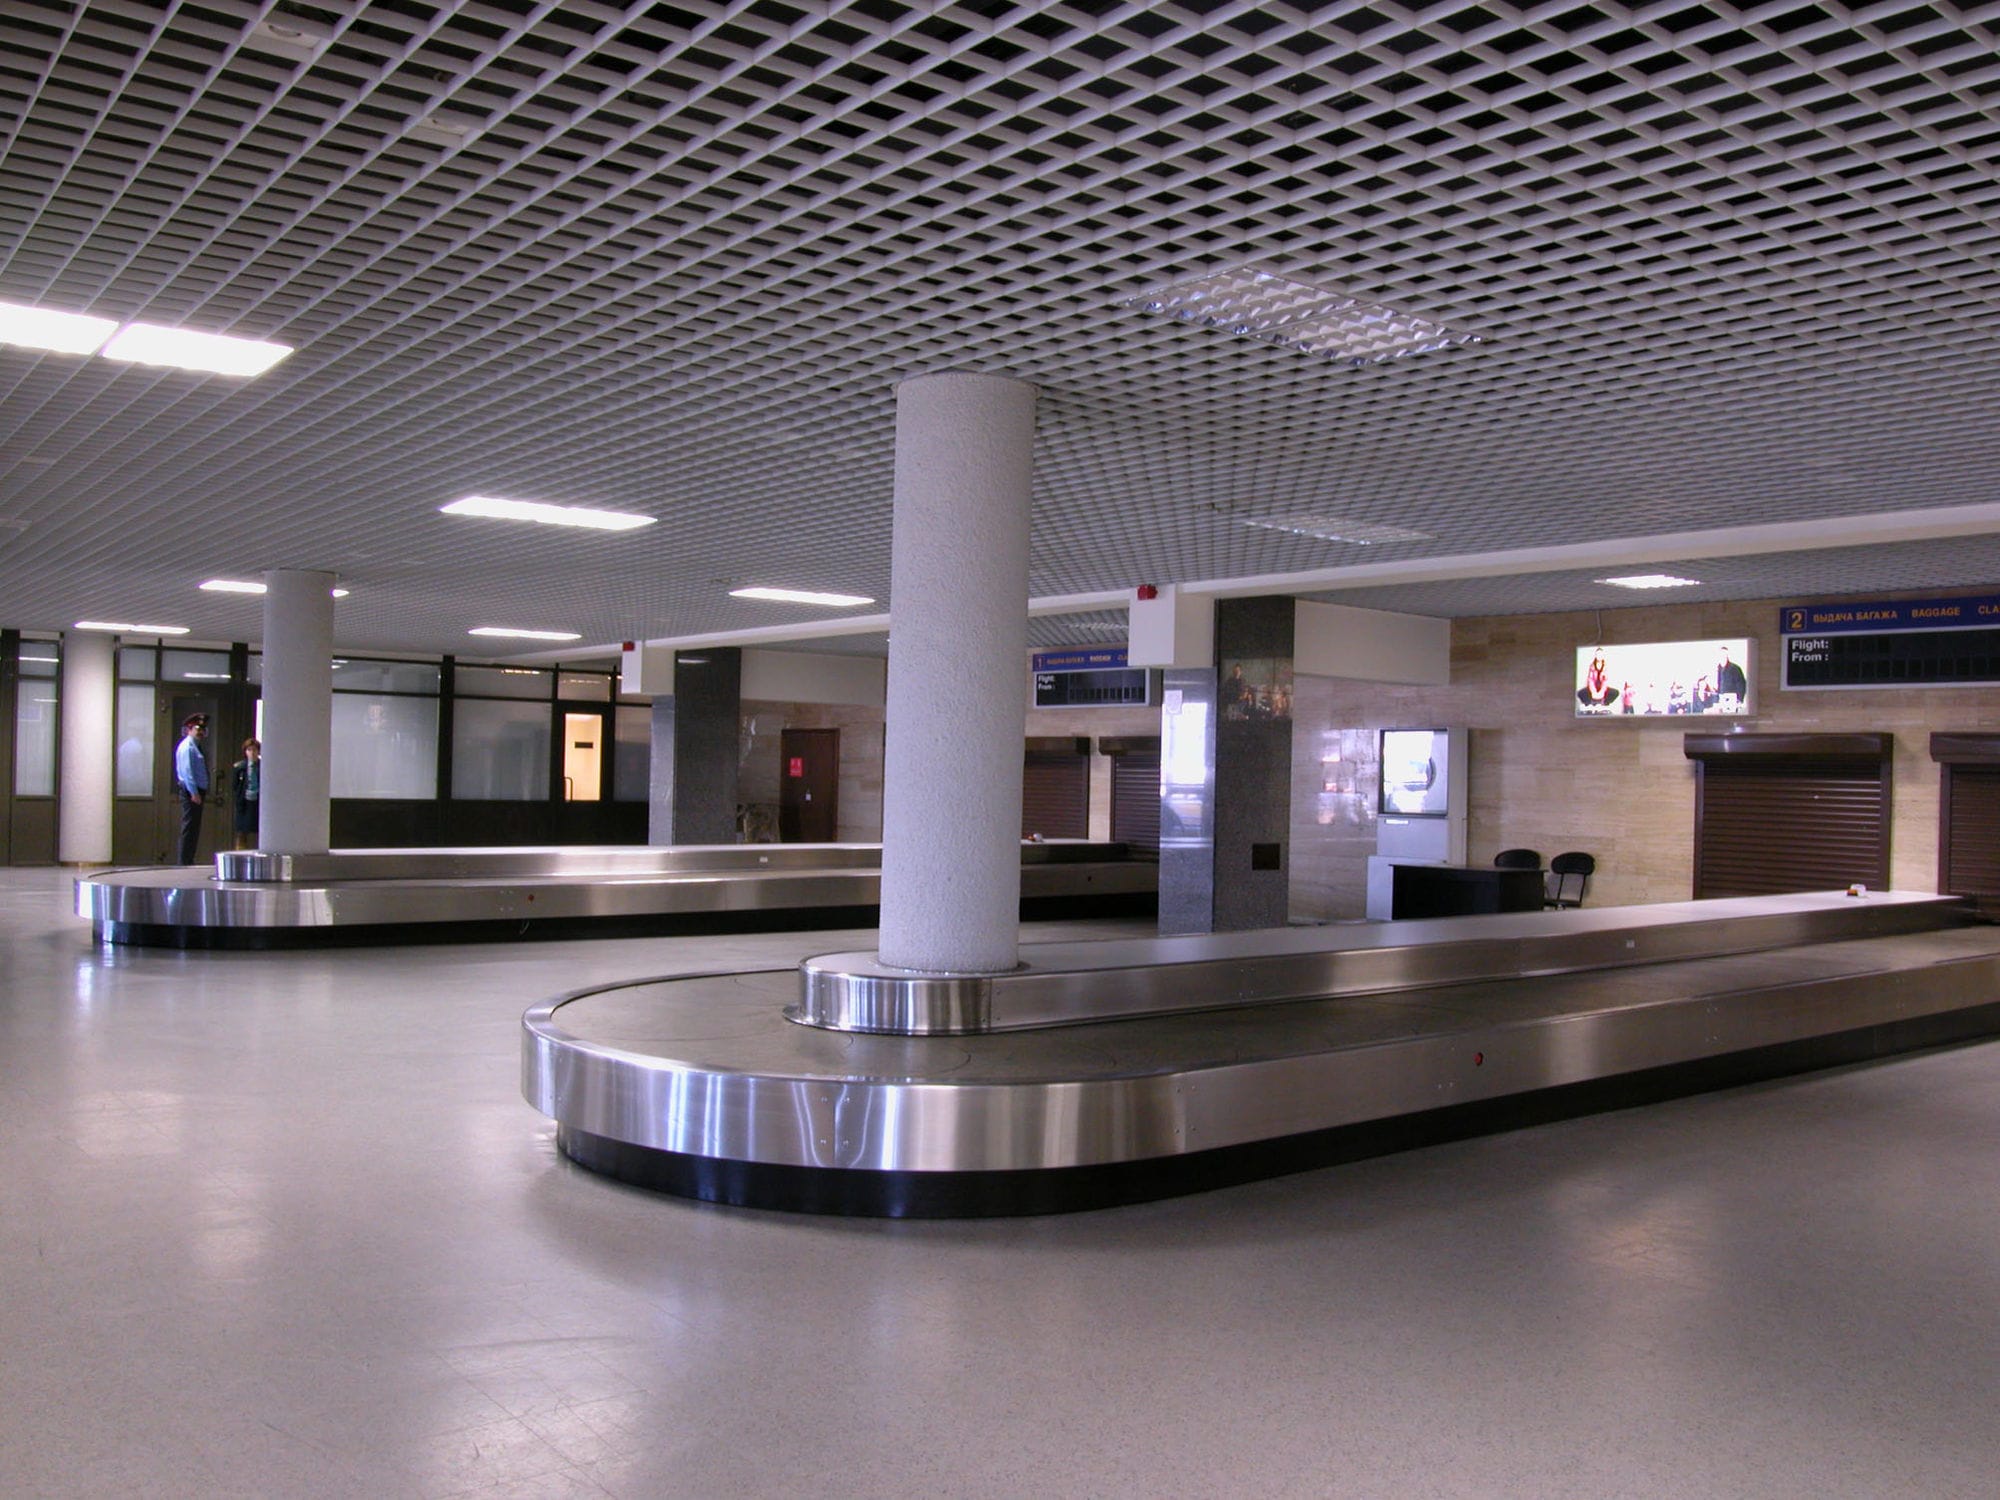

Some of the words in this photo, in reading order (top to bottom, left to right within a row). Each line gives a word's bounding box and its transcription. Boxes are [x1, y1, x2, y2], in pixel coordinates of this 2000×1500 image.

[1790, 612, 1803, 629] 2
[1812, 614, 1853, 624] ВЫДАЧА
[1856, 610, 1898, 621] БАГАЖА
[1911, 606, 1961, 618] BAGGAGE
[1791, 640, 1829, 652] Flight:
